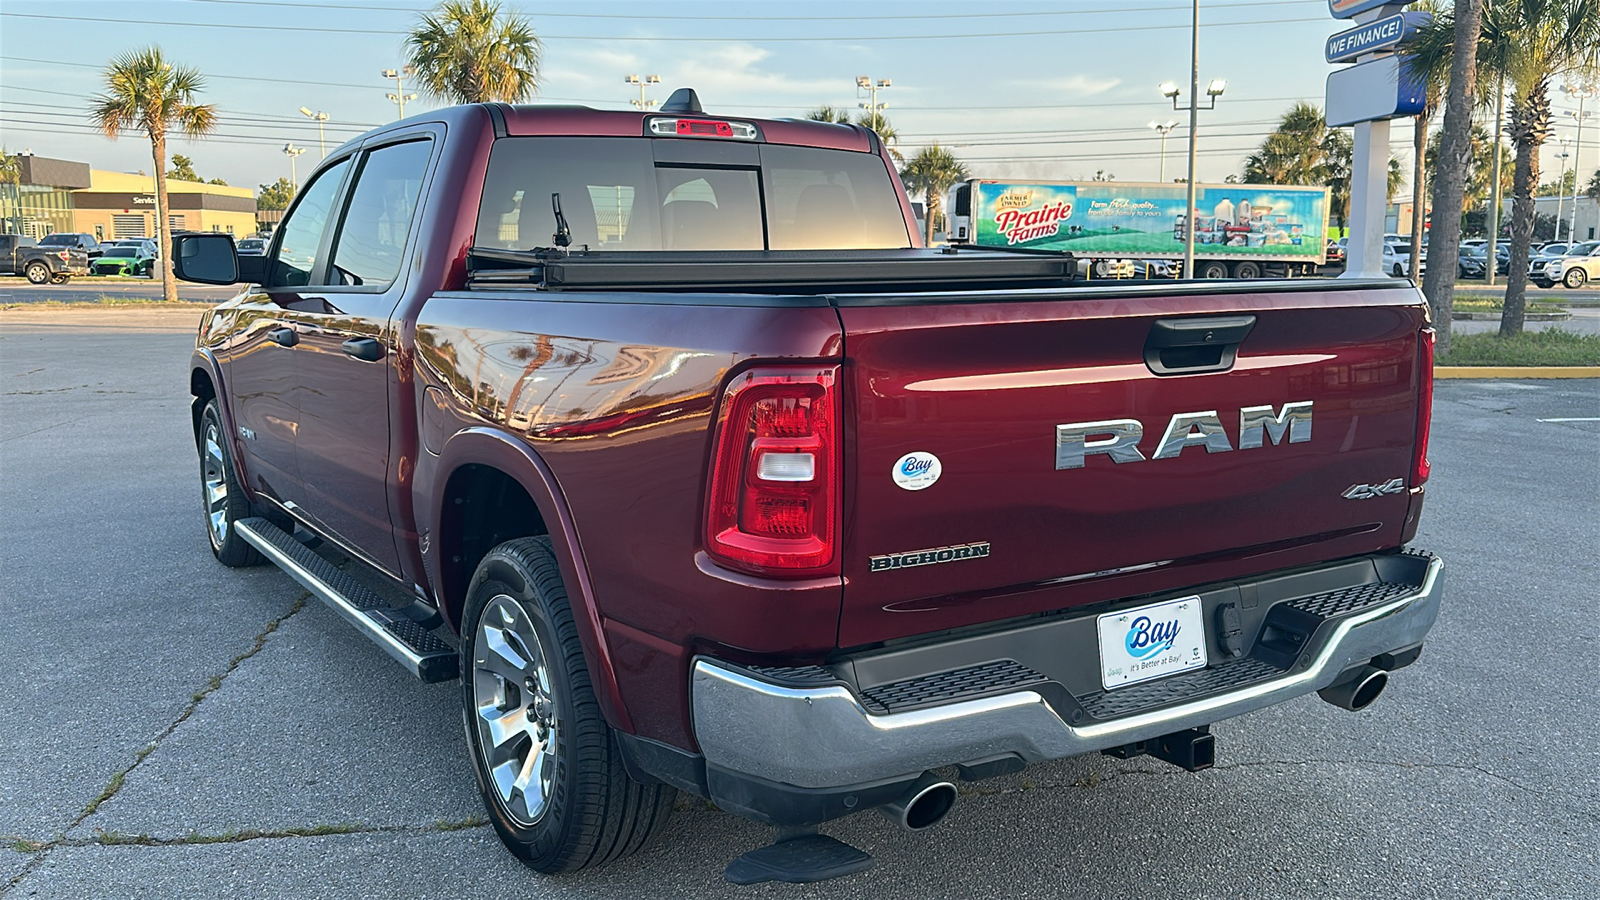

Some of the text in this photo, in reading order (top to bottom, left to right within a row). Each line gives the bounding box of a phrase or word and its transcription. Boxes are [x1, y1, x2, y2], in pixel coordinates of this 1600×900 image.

[1330, 20, 1400, 55] WE FINANCE!
[133, 196, 158, 204] Servic
[1000, 194, 1028, 202] FARMER
[1091, 200, 1108, 208] Farm
[995, 201, 1071, 231] Prairie
[1088, 207, 1103, 216] from
[1116, 208, 1136, 218] family
[1144, 210, 1162, 218] yours
[1007, 223, 1058, 243] Farms
[1055, 400, 1314, 470] RAM
[904, 456, 934, 474] Bay
[869, 541, 990, 572] BIGHORN
[1130, 616, 1181, 650] Bay
[1130, 662, 1141, 672] It's
[1141, 659, 1160, 670] Better
[1160, 657, 1168, 666] at
[1168, 654, 1182, 665] Bay!
